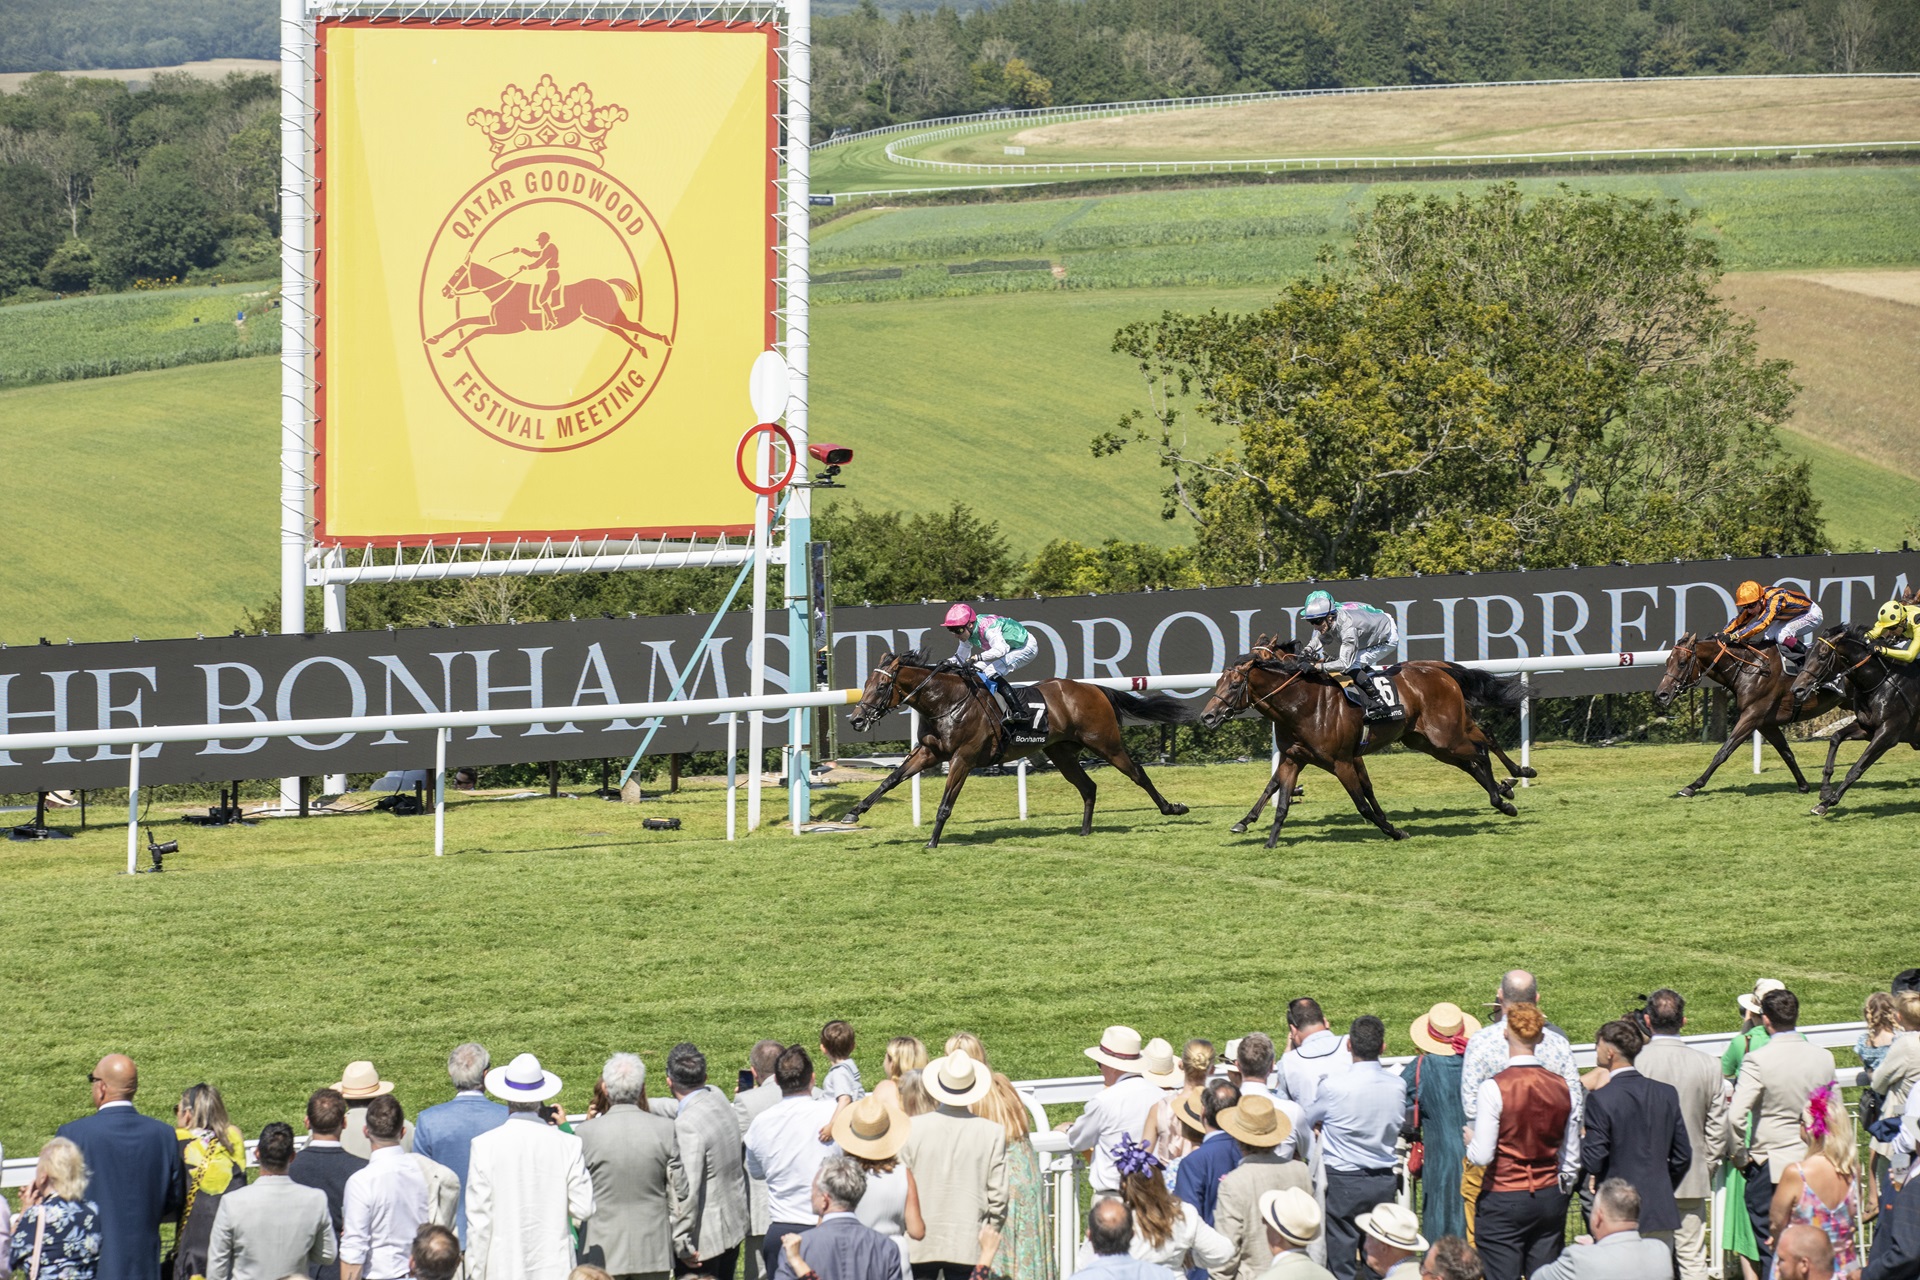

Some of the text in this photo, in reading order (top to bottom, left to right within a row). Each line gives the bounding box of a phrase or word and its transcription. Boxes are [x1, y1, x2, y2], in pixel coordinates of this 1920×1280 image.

[452, 170, 644, 240] QATAR GOODWOOD
[453, 368, 647, 441] FESTIVAL MEETING
[1623, 654, 1631, 666] 3
[194, 633, 791, 756] BONHAMS
[1373, 676, 1396, 706] 6
[1028, 702, 1046, 729] 7
[1015, 735, 1046, 743] Bonhams
